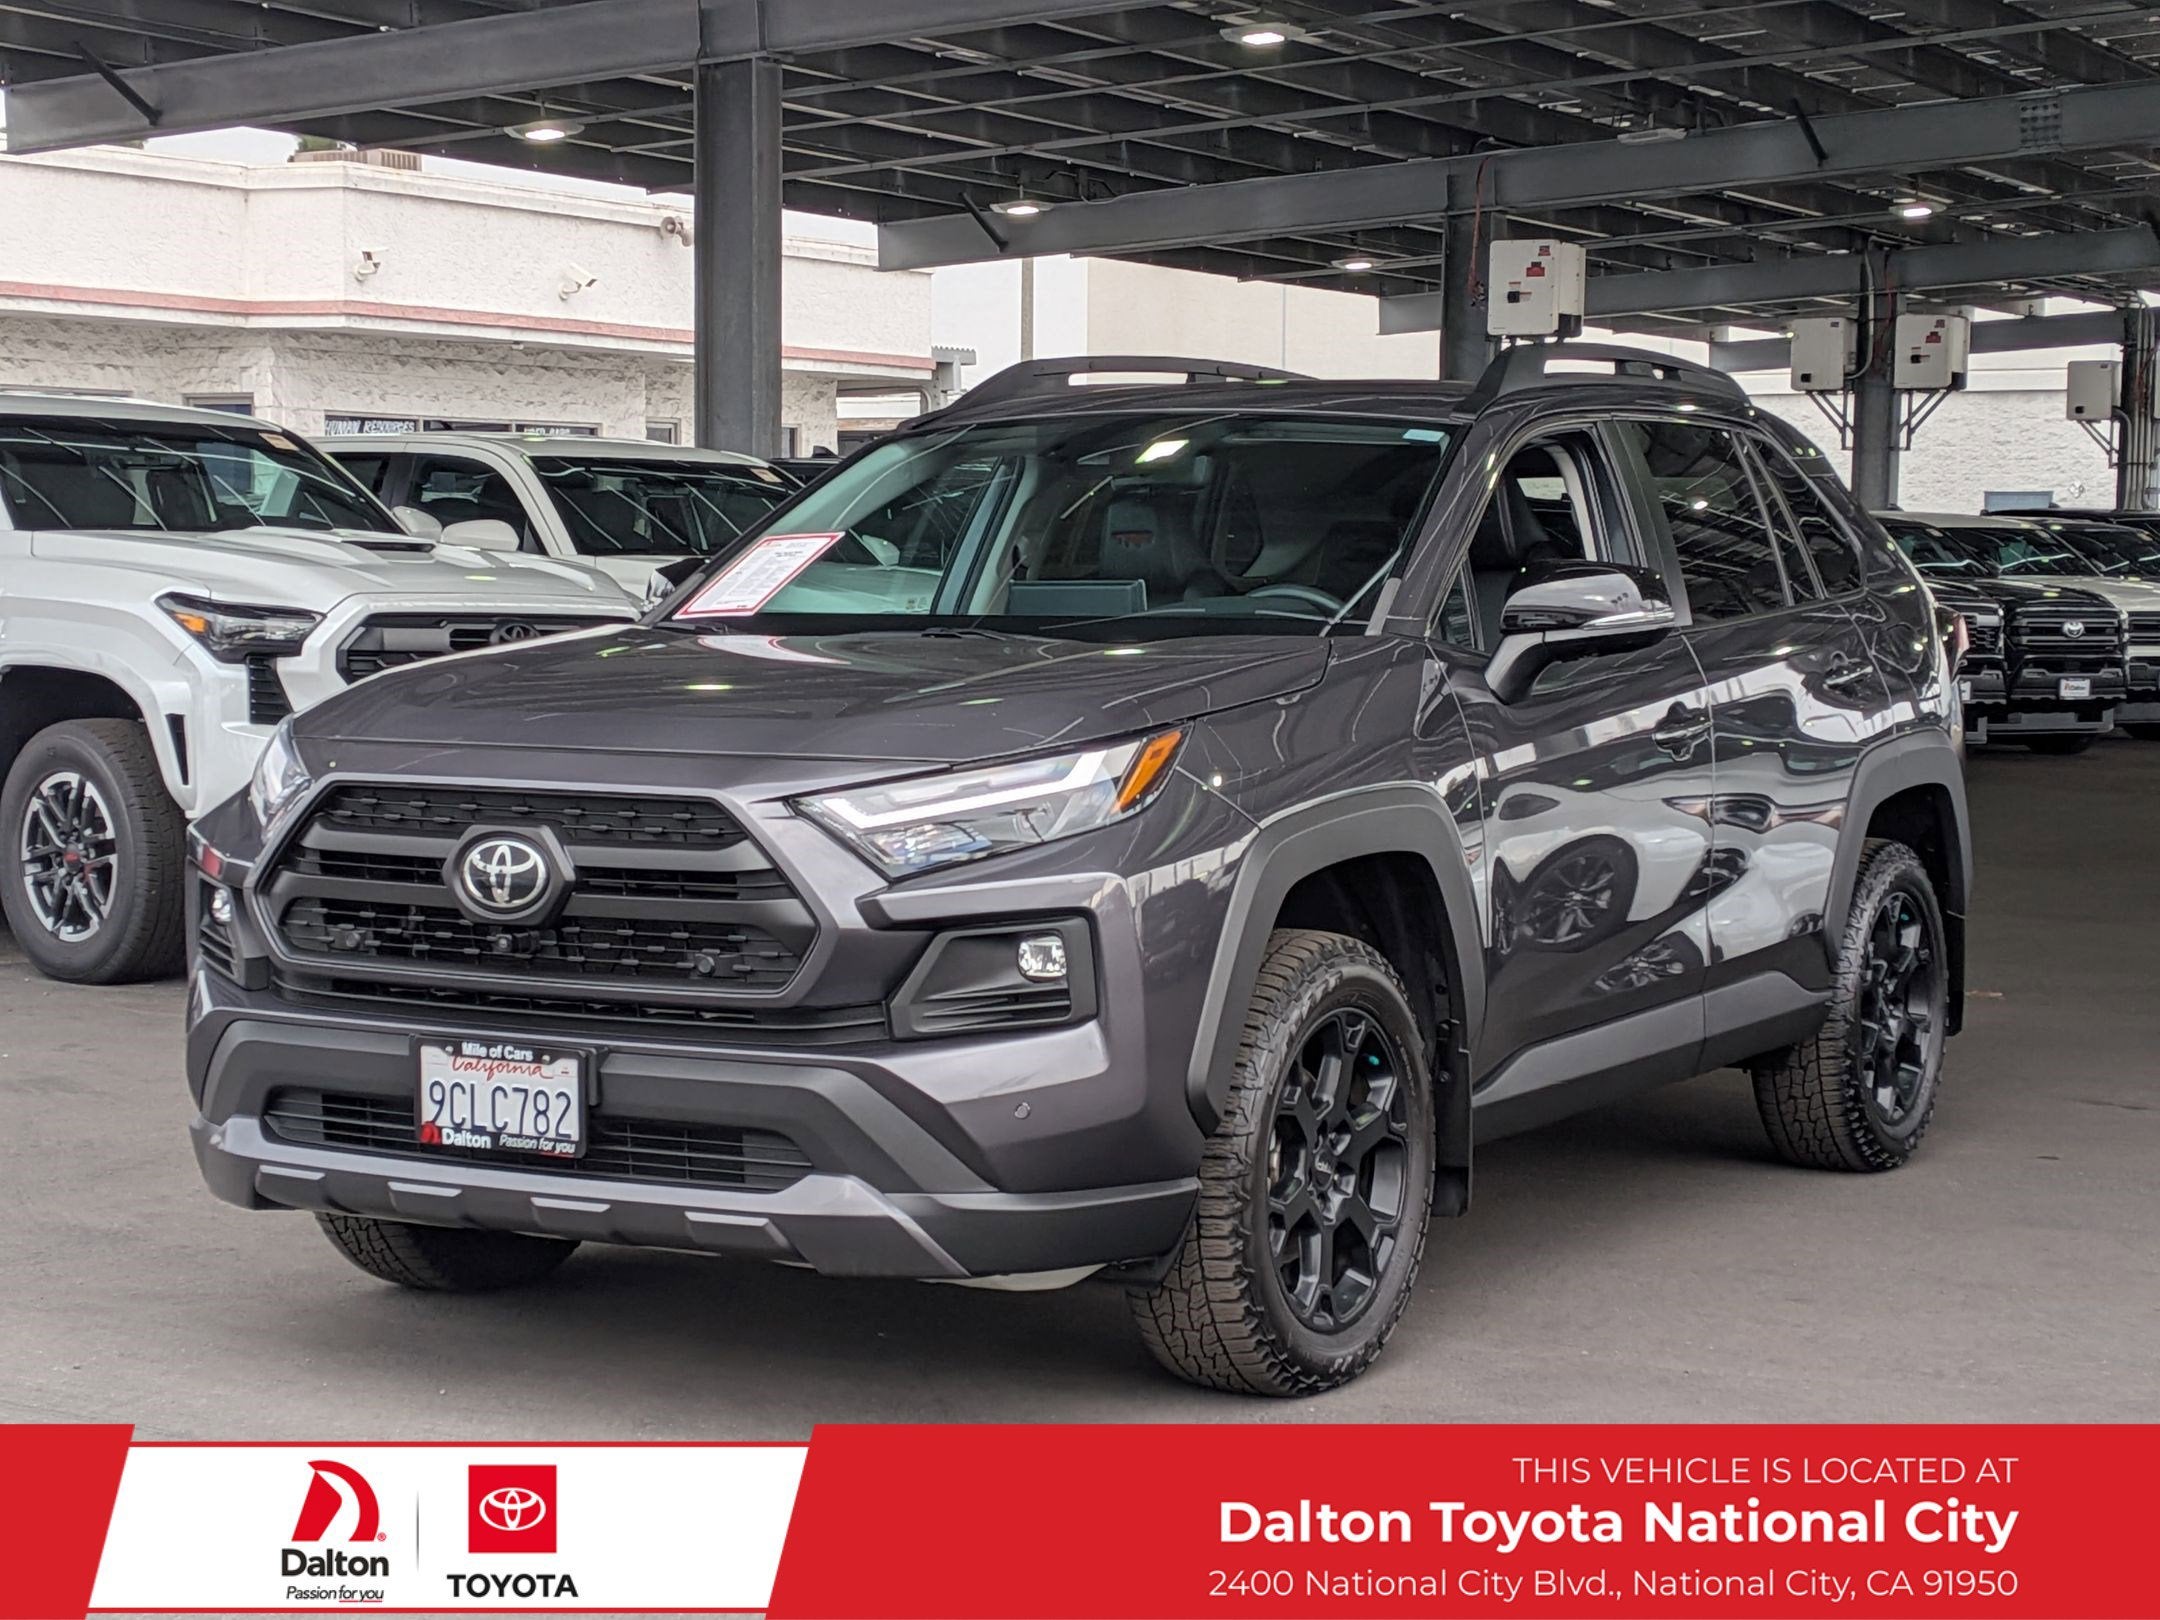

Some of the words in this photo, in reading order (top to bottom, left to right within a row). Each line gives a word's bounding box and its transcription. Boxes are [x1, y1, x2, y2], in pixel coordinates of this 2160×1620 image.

[325, 419, 360, 435] HUMAN
[363, 420, 415, 433] RESOURCES
[461, 1041, 487, 1058] Mile
[488, 1044, 503, 1059] of
[504, 1046, 534, 1062] Cars
[452, 1056, 554, 1082] California
[429, 1079, 573, 1140] 9CLC782
[441, 1127, 492, 1150] Dalton
[499, 1133, 538, 1150] Passion
[538, 1137, 554, 1151] for
[554, 1141, 576, 1154] you
